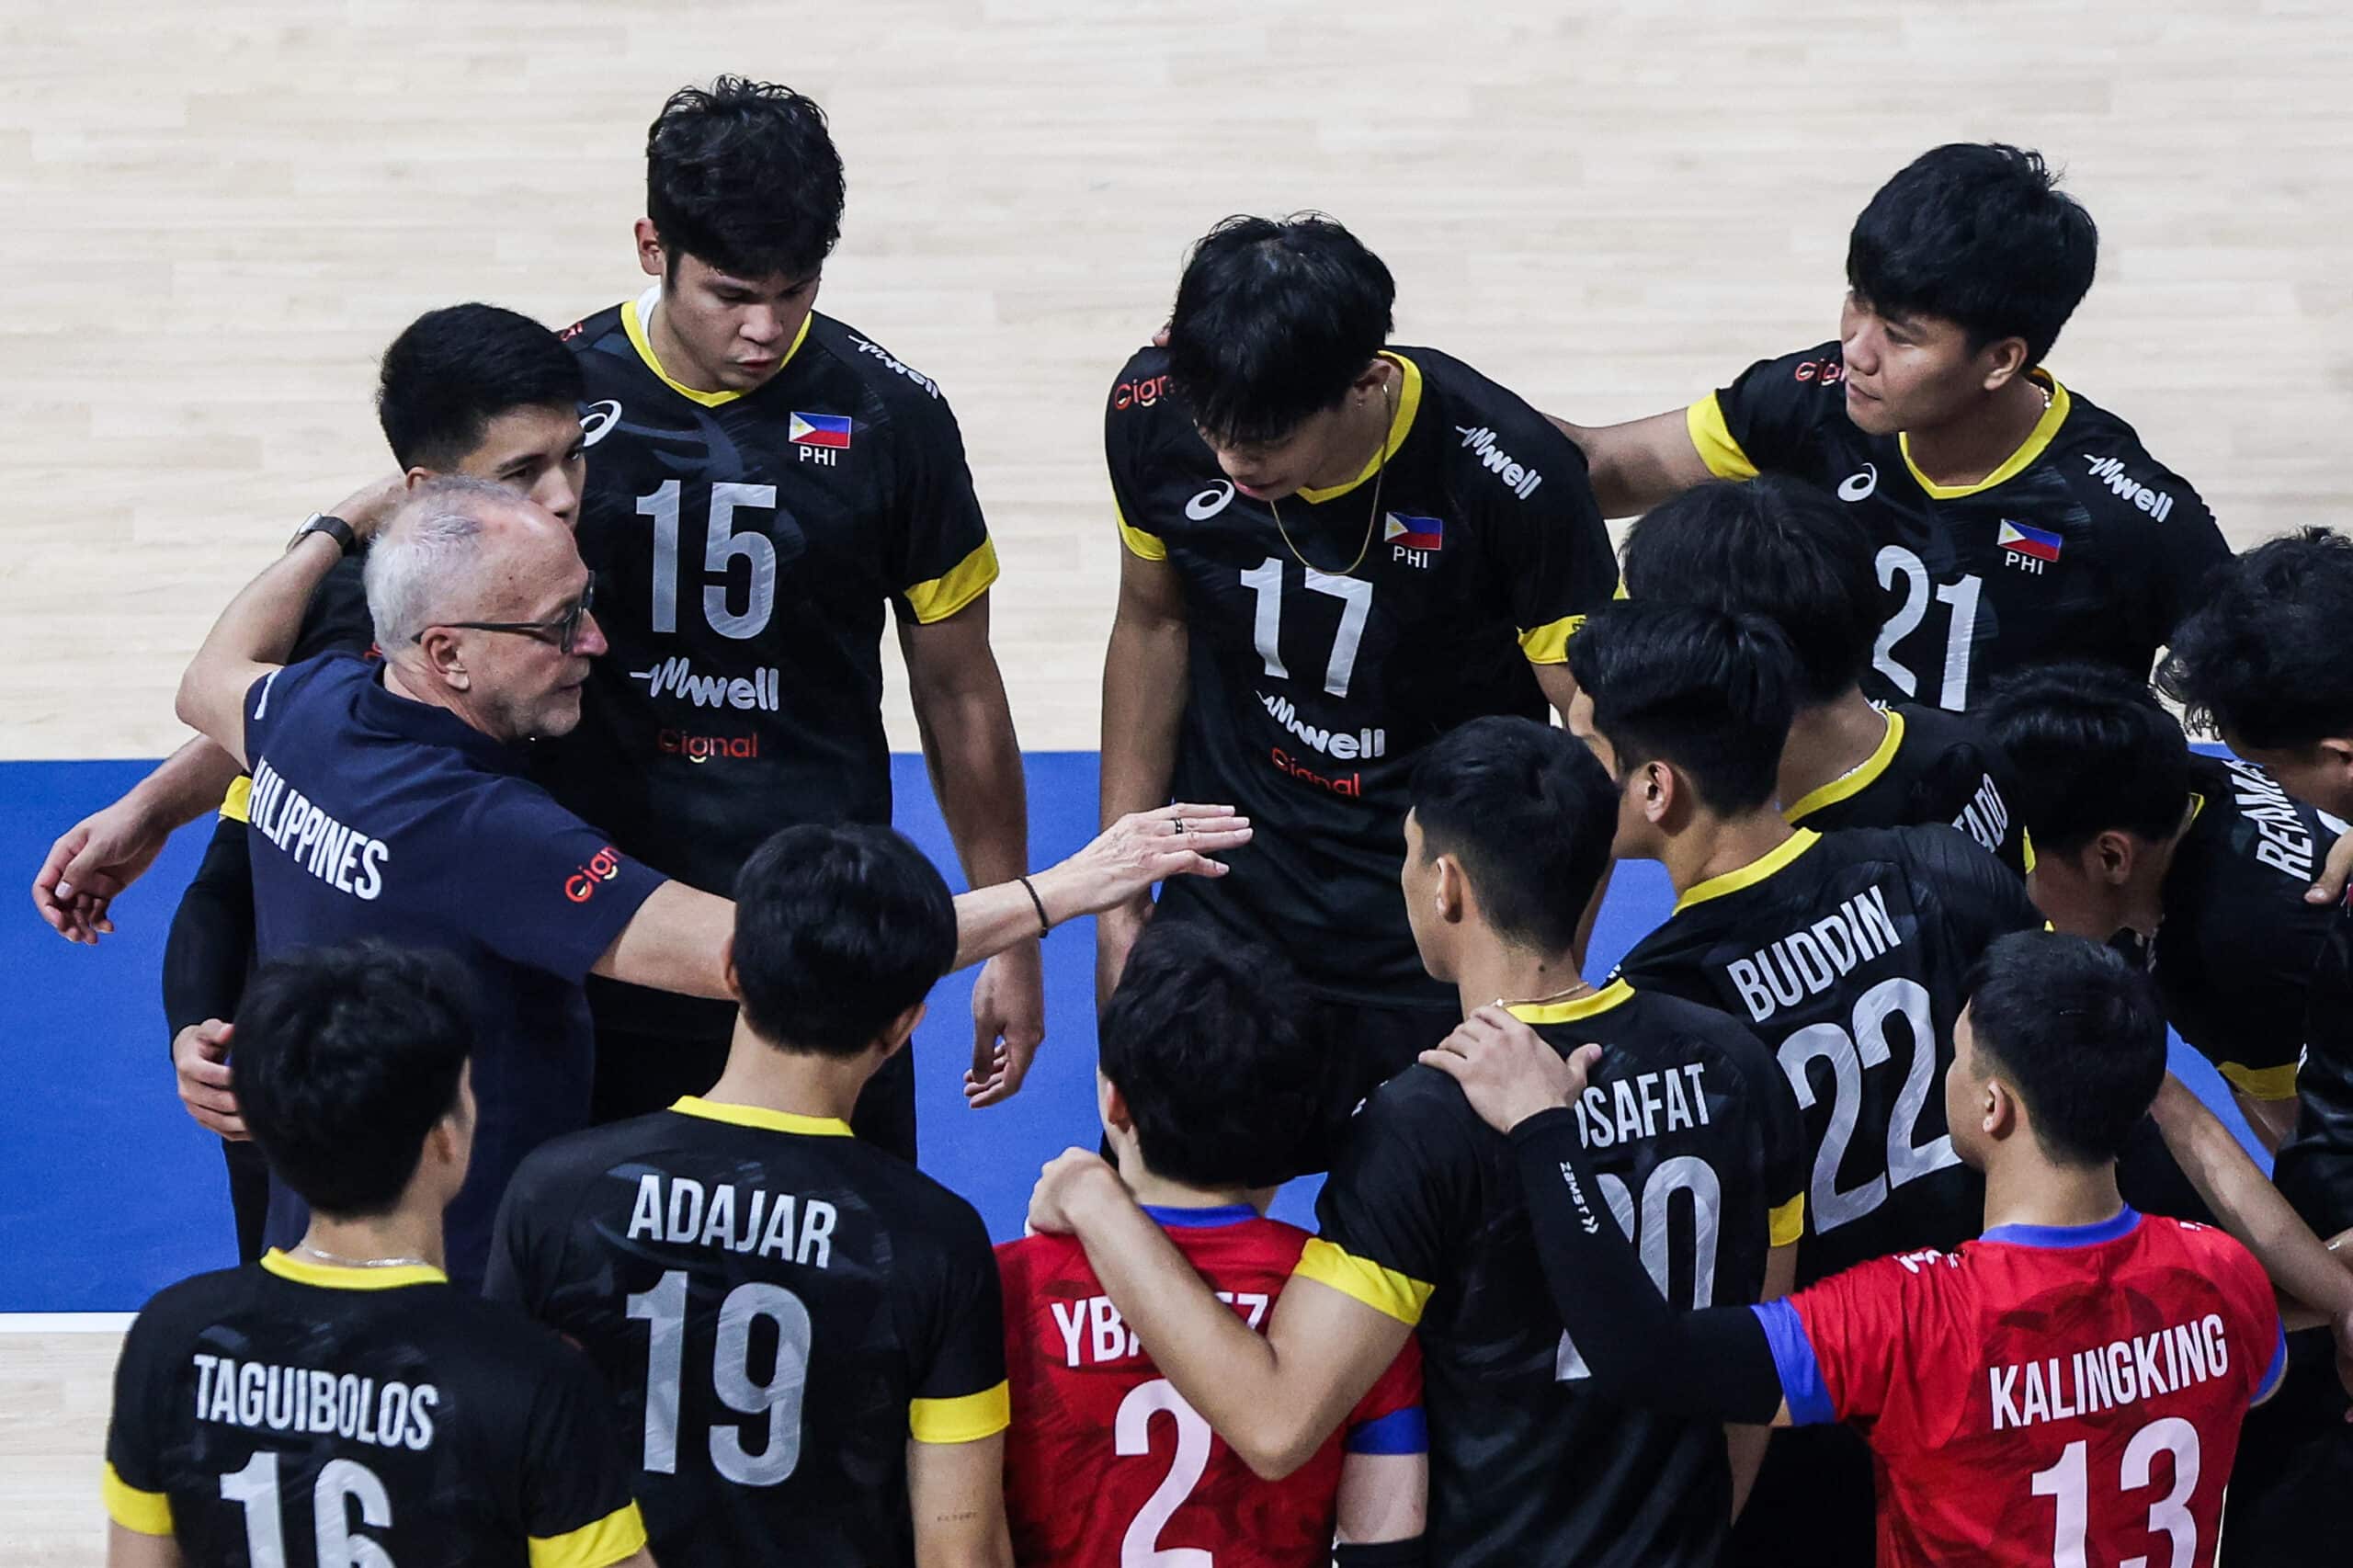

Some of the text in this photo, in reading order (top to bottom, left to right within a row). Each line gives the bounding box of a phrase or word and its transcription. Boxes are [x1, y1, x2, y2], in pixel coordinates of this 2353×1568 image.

[799, 446, 836, 467] PHI
[636, 480, 778, 640] 15
[1392, 545, 1428, 569] PHI
[2005, 551, 2044, 576] PHI
[1240, 557, 1373, 699] 17
[1872, 544, 1983, 712] 21
[659, 729, 758, 763] Cignal
[247, 756, 389, 900] HILIPPINES
[1727, 885, 1901, 1023] BUDDIN
[1574, 1062, 1710, 1149] SAFAT
[1776, 977, 1964, 1235] 22
[627, 1174, 837, 1268] ADAJAR
[193, 1353, 440, 1451] TAGUIBOLOS
[626, 1270, 813, 1487] 19
[1989, 1313, 2229, 1430] KALINGKING
[220, 1451, 398, 1568] 16
[1115, 1379, 1213, 1568] 2
[2031, 1416, 2200, 1568] 13
